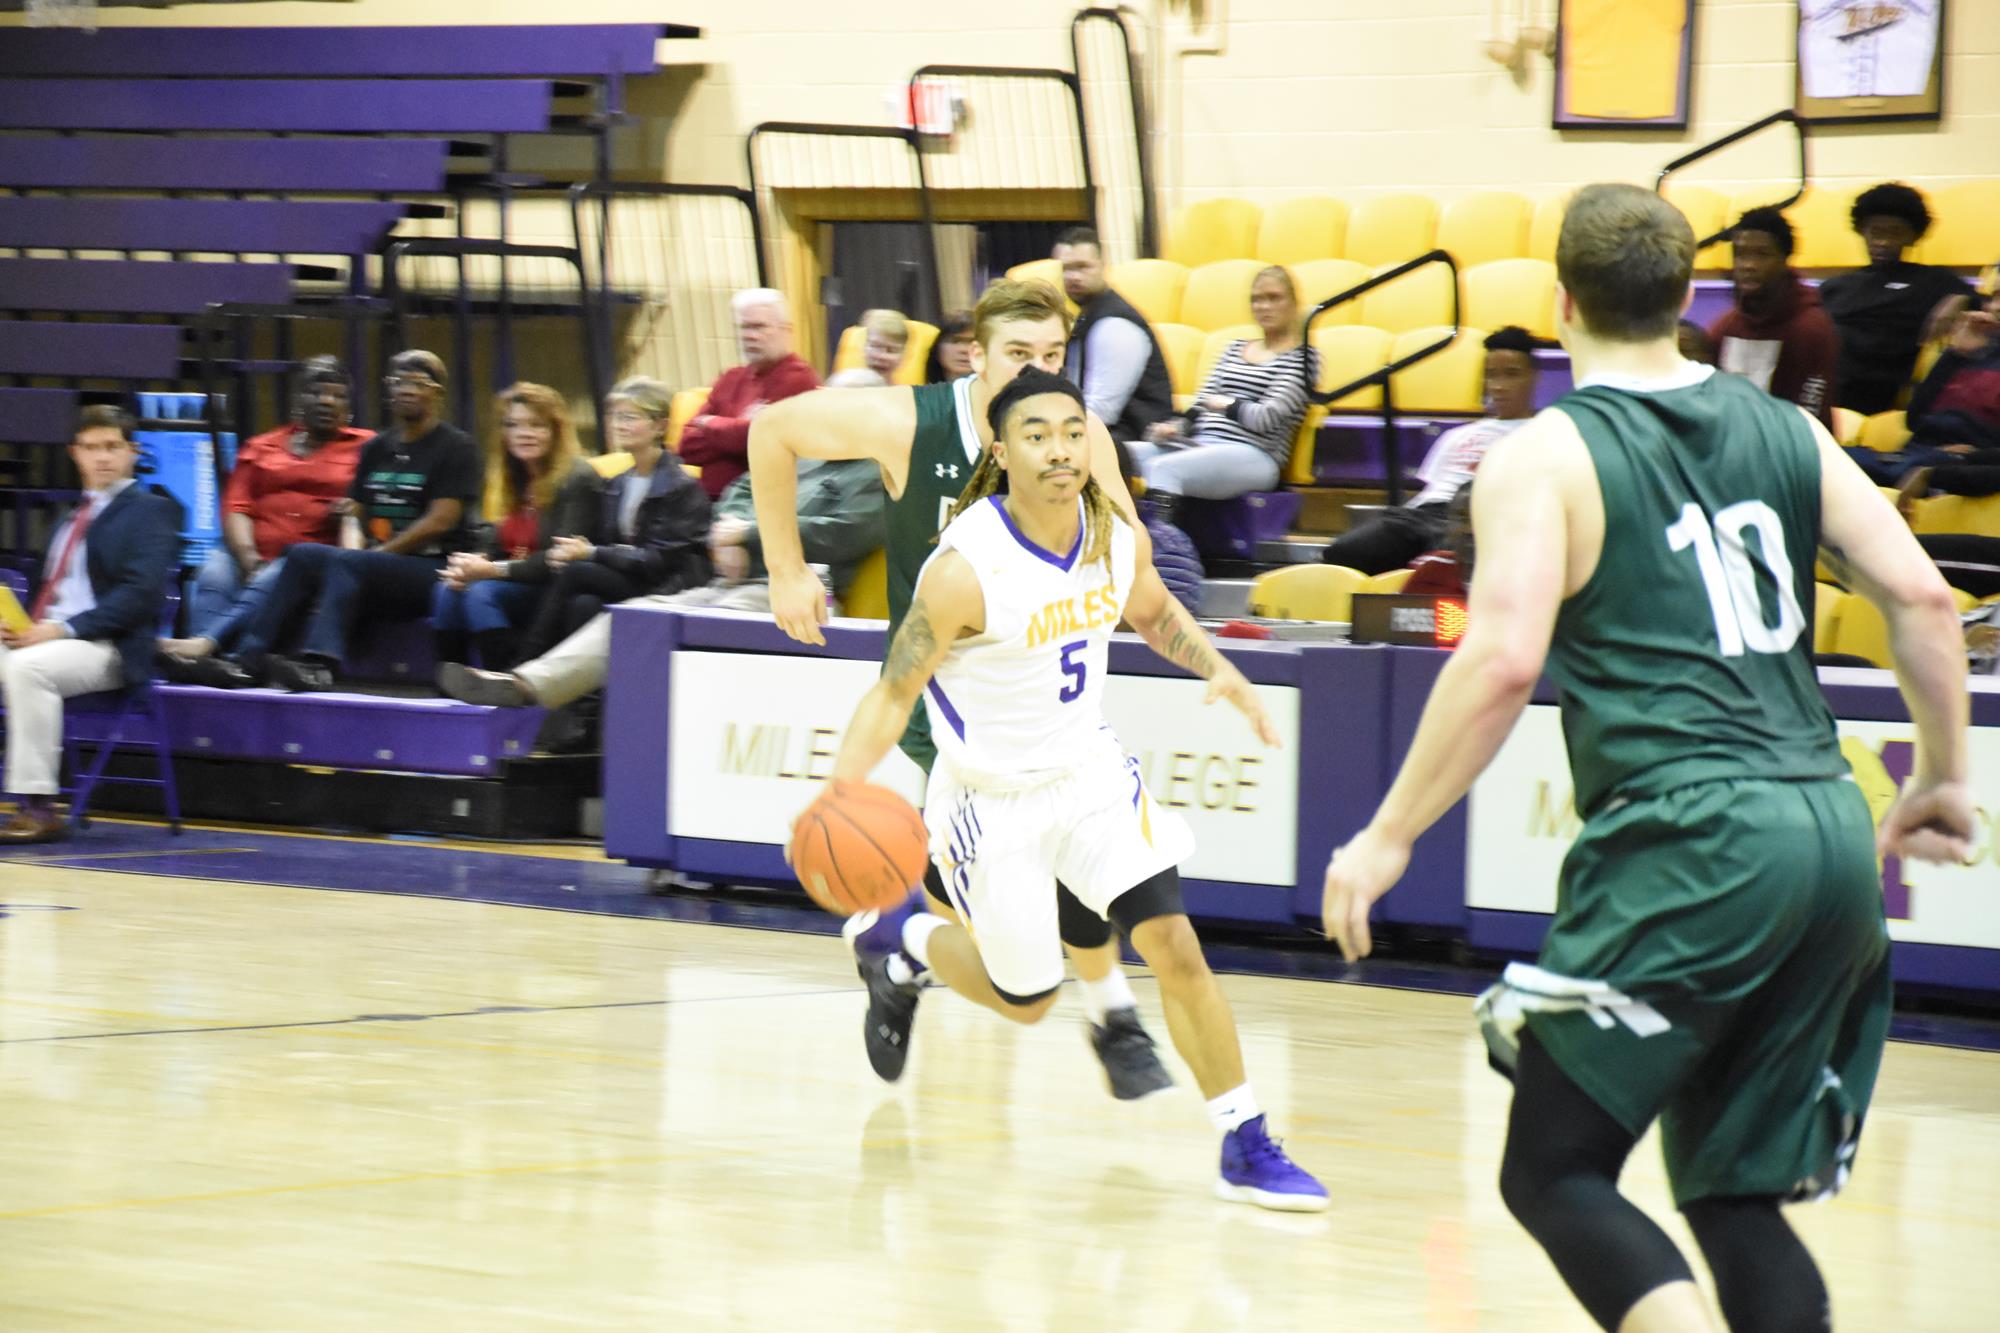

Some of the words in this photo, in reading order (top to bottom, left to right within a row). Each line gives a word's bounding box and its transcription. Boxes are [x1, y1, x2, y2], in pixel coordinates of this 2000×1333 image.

[1026, 584, 1119, 649] MILES
[1665, 499, 1807, 657] 10
[1059, 639, 1088, 704] 5
[718, 721, 840, 781] MILE
[1141, 750, 1264, 814] LEGE
